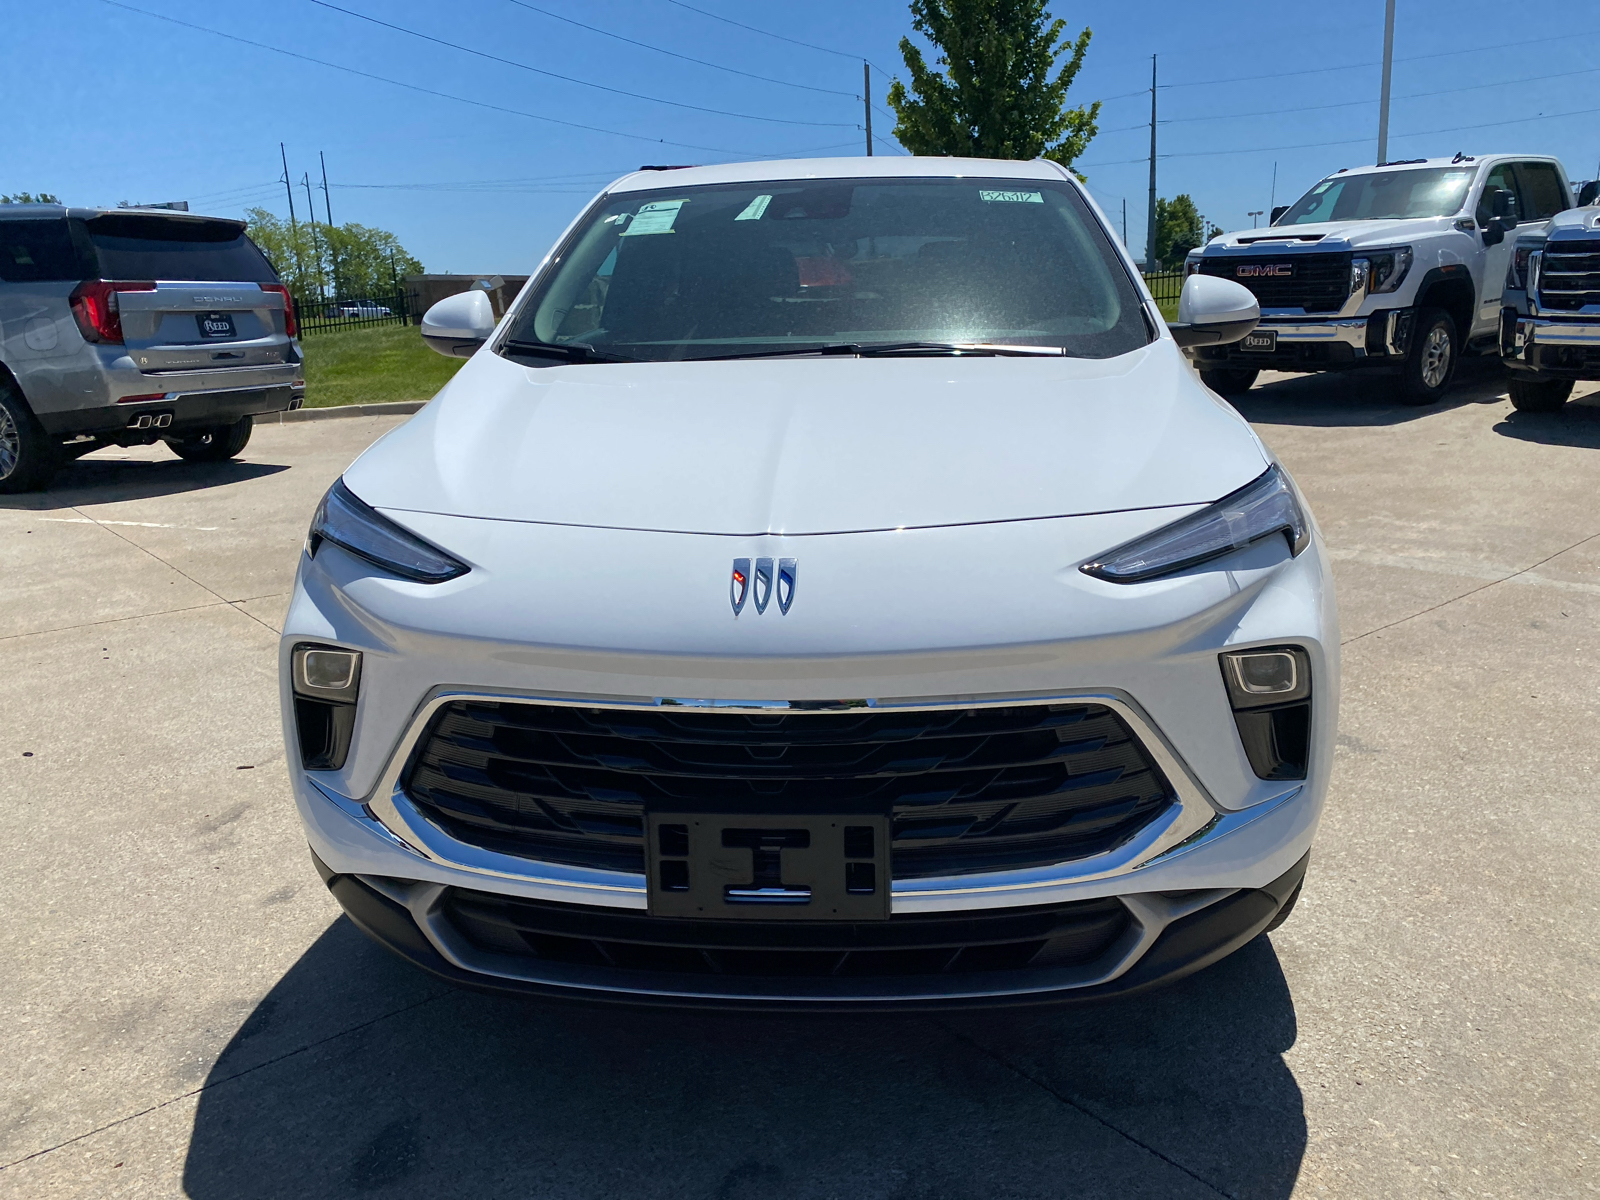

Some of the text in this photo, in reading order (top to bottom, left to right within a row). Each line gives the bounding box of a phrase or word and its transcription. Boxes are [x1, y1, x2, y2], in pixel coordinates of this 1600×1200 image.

[1236, 263, 1293, 277] GMC
[204, 320, 230, 333] REED
[1245, 336, 1271, 347] REED
